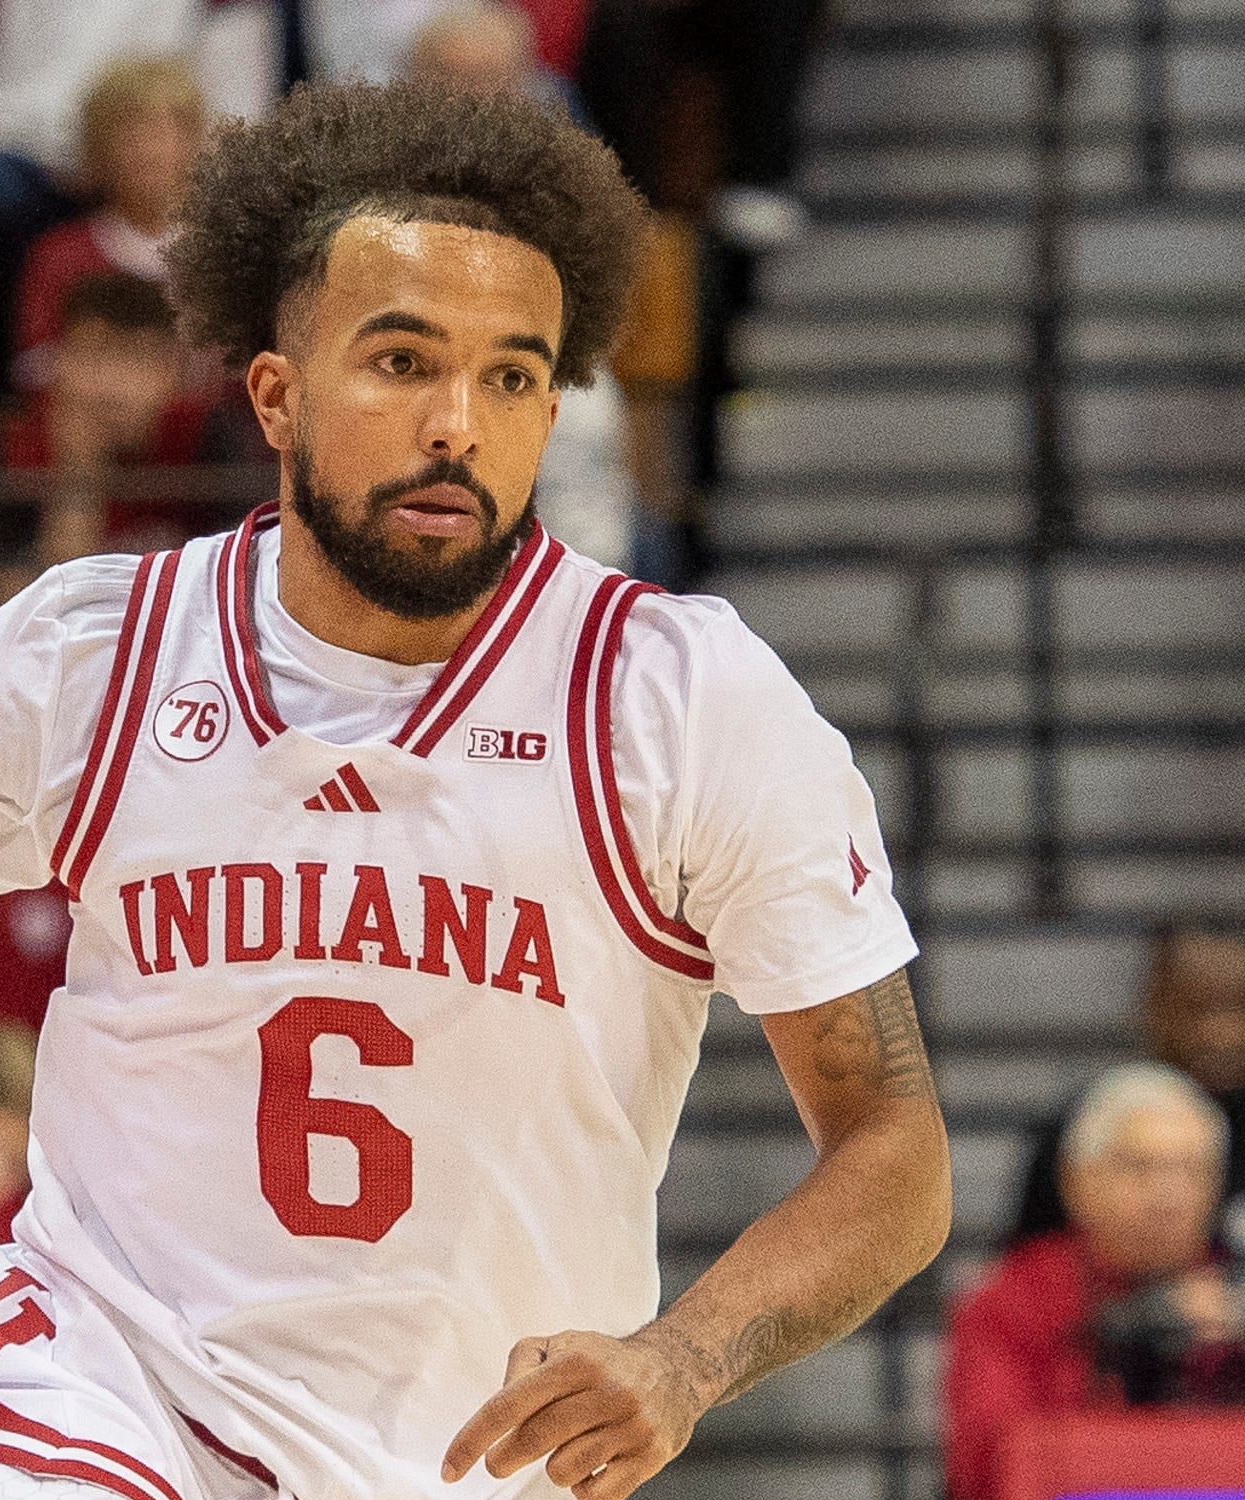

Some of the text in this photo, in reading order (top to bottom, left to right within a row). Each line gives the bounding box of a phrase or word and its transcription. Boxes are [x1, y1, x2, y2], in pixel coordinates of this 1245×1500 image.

[168, 697, 220, 743] '76
[119, 862, 566, 1008] INDIANA
[257, 996, 415, 1244] 6
